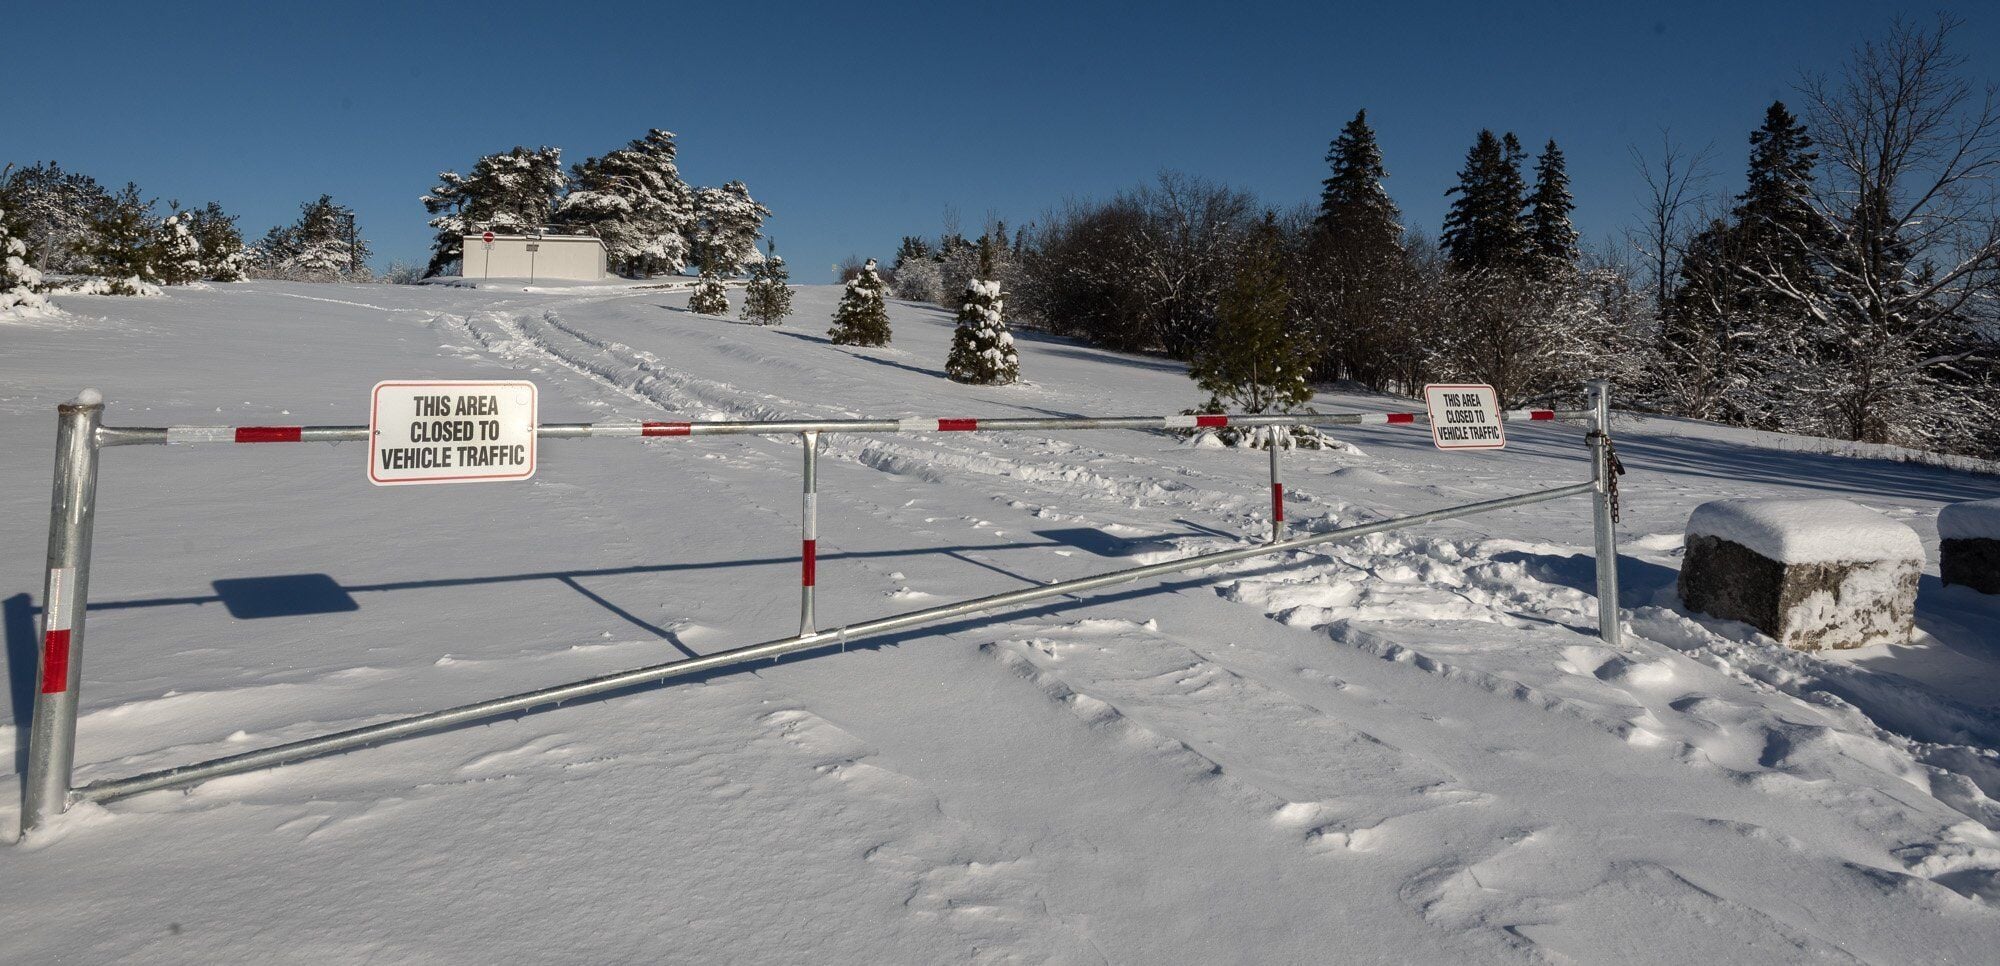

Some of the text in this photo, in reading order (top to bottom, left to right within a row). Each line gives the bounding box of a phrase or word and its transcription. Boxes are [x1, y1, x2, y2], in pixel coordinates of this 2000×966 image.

[413, 395, 499, 417] THIS AREA
[1443, 394, 1481, 407] THIS AREA
[1446, 410, 1485, 423] CLOSED TO
[410, 420, 500, 443] CLOSED TO
[1437, 426, 1499, 440] VEHICLE TRAFFIC
[381, 444, 525, 470] VEHICLE TRAFFIC
